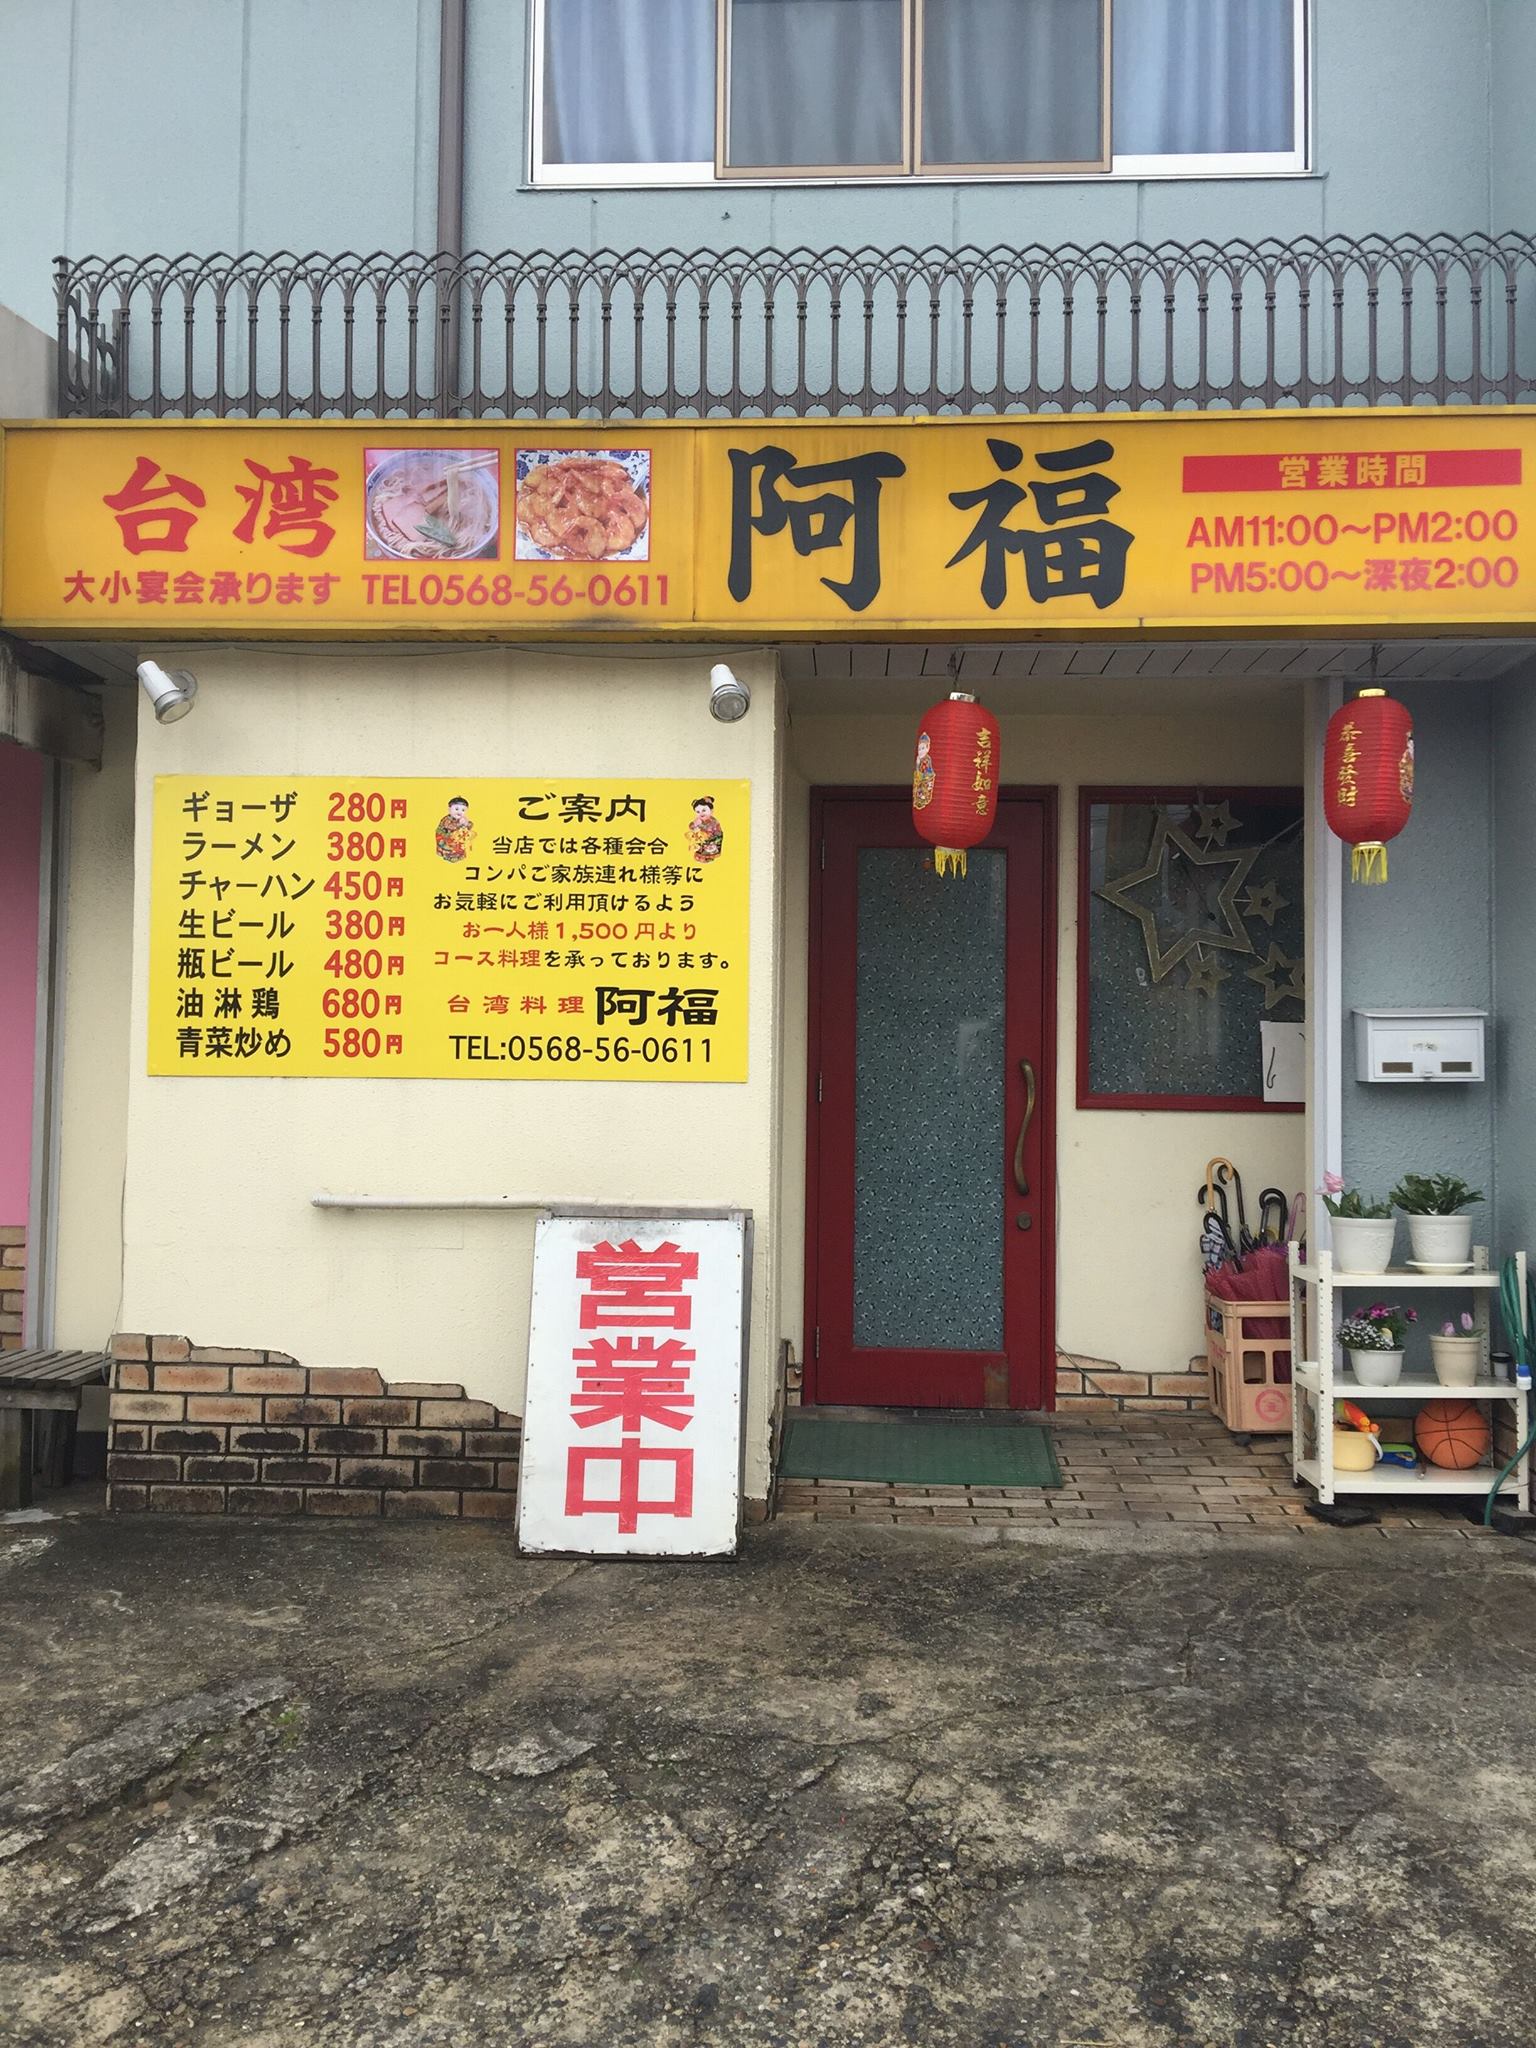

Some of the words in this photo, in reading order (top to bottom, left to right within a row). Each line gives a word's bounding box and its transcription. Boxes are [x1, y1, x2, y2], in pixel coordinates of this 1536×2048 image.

[1278, 454, 1428, 489] 営業時間
[104, 457, 337, 558] 台湾
[727, 438, 1136, 612] 阿福
[64, 571, 338, 605] 大小宴会承ります
[363, 575, 668, 605] TEL0568-56-0611
[971, 727, 991, 815] 吉祥如意
[182, 790, 298, 823] ギョーザ
[327, 792, 407, 823] 280円
[518, 792, 646, 824] ご案内
[182, 832, 296, 861] ラーメン
[328, 831, 406, 862] 380円
[492, 835, 669, 855] 当店では各種会合
[179, 870, 315, 901] チャーハン
[323, 870, 404, 901] 450円
[465, 864, 703, 886] コンパご家族連れ様等に
[433, 891, 694, 913] お気軽にご利用頂けるよう
[178, 908, 295, 940] 生ビール
[326, 909, 405, 940] 380円
[464, 922, 694, 940] お一人様1,500円より
[177, 947, 295, 979] 瓶ビール
[324, 949, 404, 980] 480円
[434, 950, 729, 970] コース料理を承っております。
[176, 987, 280, 1020] 油淋鶏
[322, 988, 402, 1019] 680円
[449, 995, 583, 1014] 台湾料理
[594, 986, 719, 1027] 阿福
[176, 1026, 291, 1058] 青菜炒め
[324, 1027, 403, 1058] 580円
[448, 1035, 710, 1063] TEL:0568-56-0611
[565, 1240, 698, 1533] 営業中
